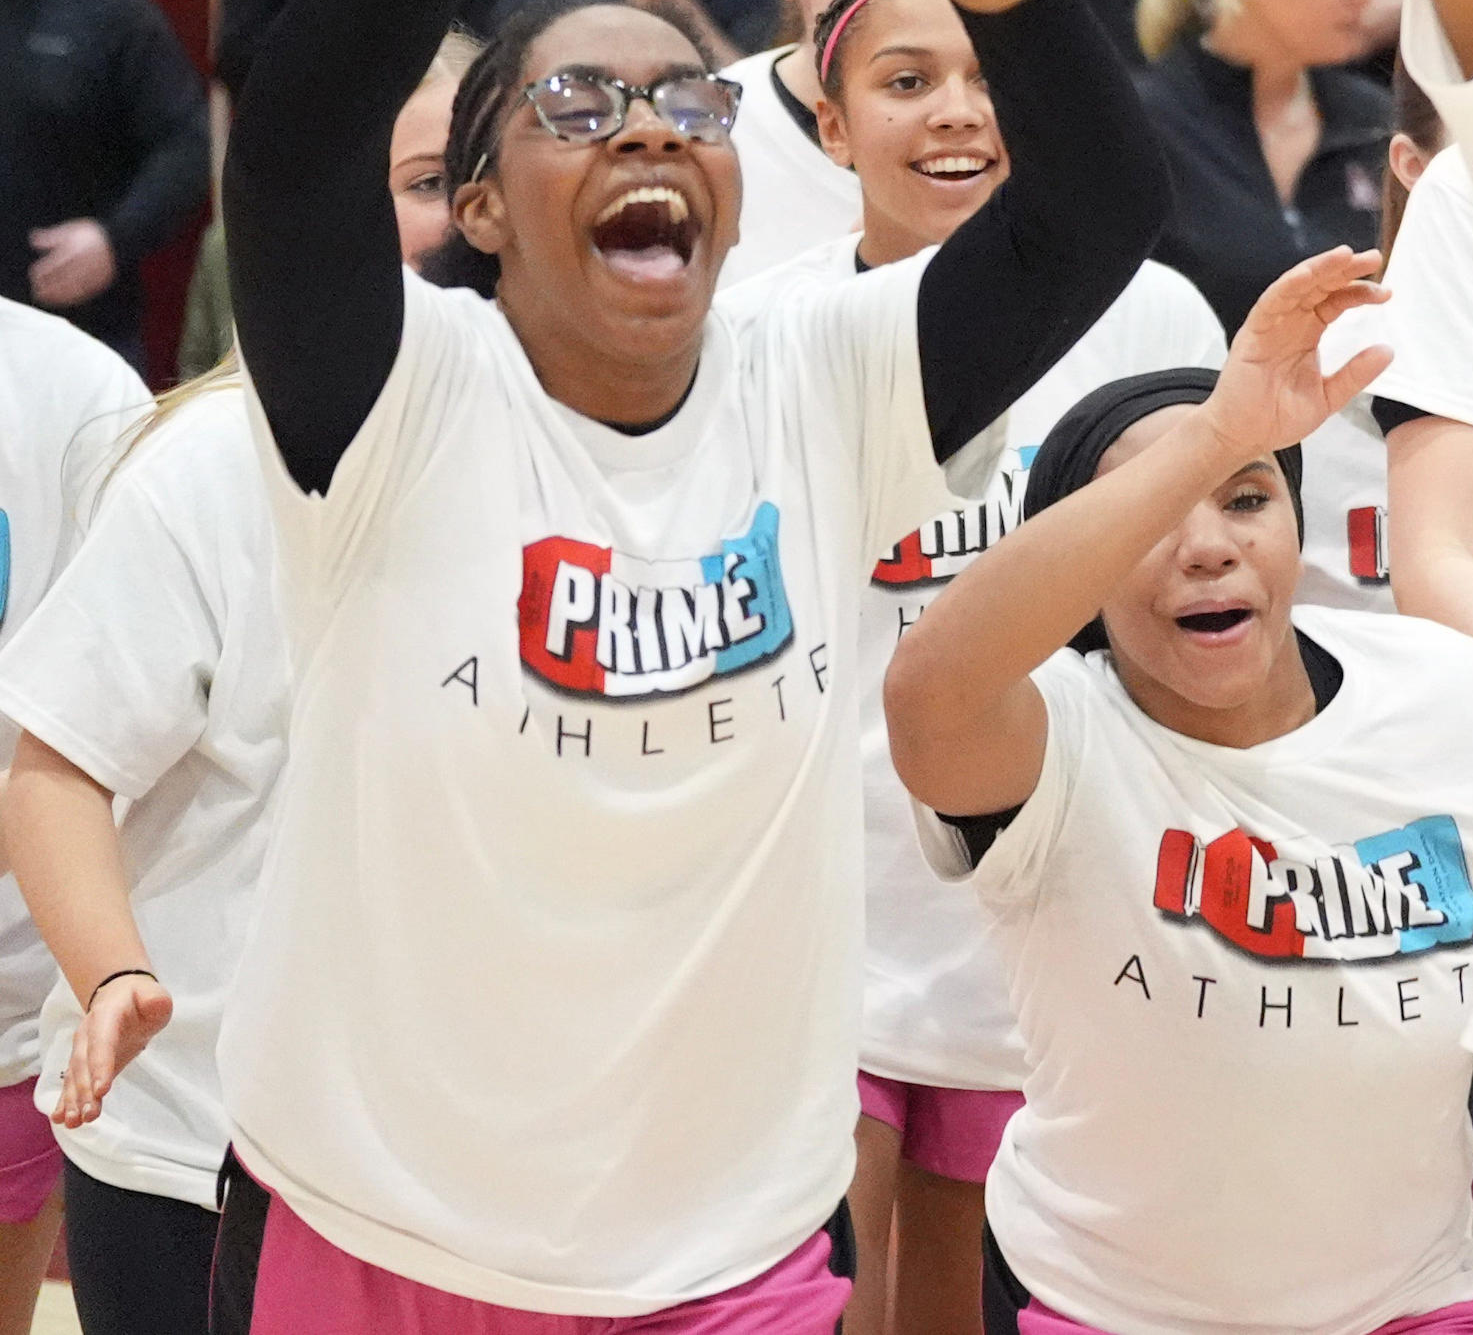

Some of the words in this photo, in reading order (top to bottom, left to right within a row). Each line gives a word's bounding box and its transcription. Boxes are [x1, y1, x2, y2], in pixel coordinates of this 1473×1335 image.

[545, 552, 766, 674] PRIME
[1246, 845, 1447, 939] PRIME
[1114, 954, 1470, 1028] ATHLET
